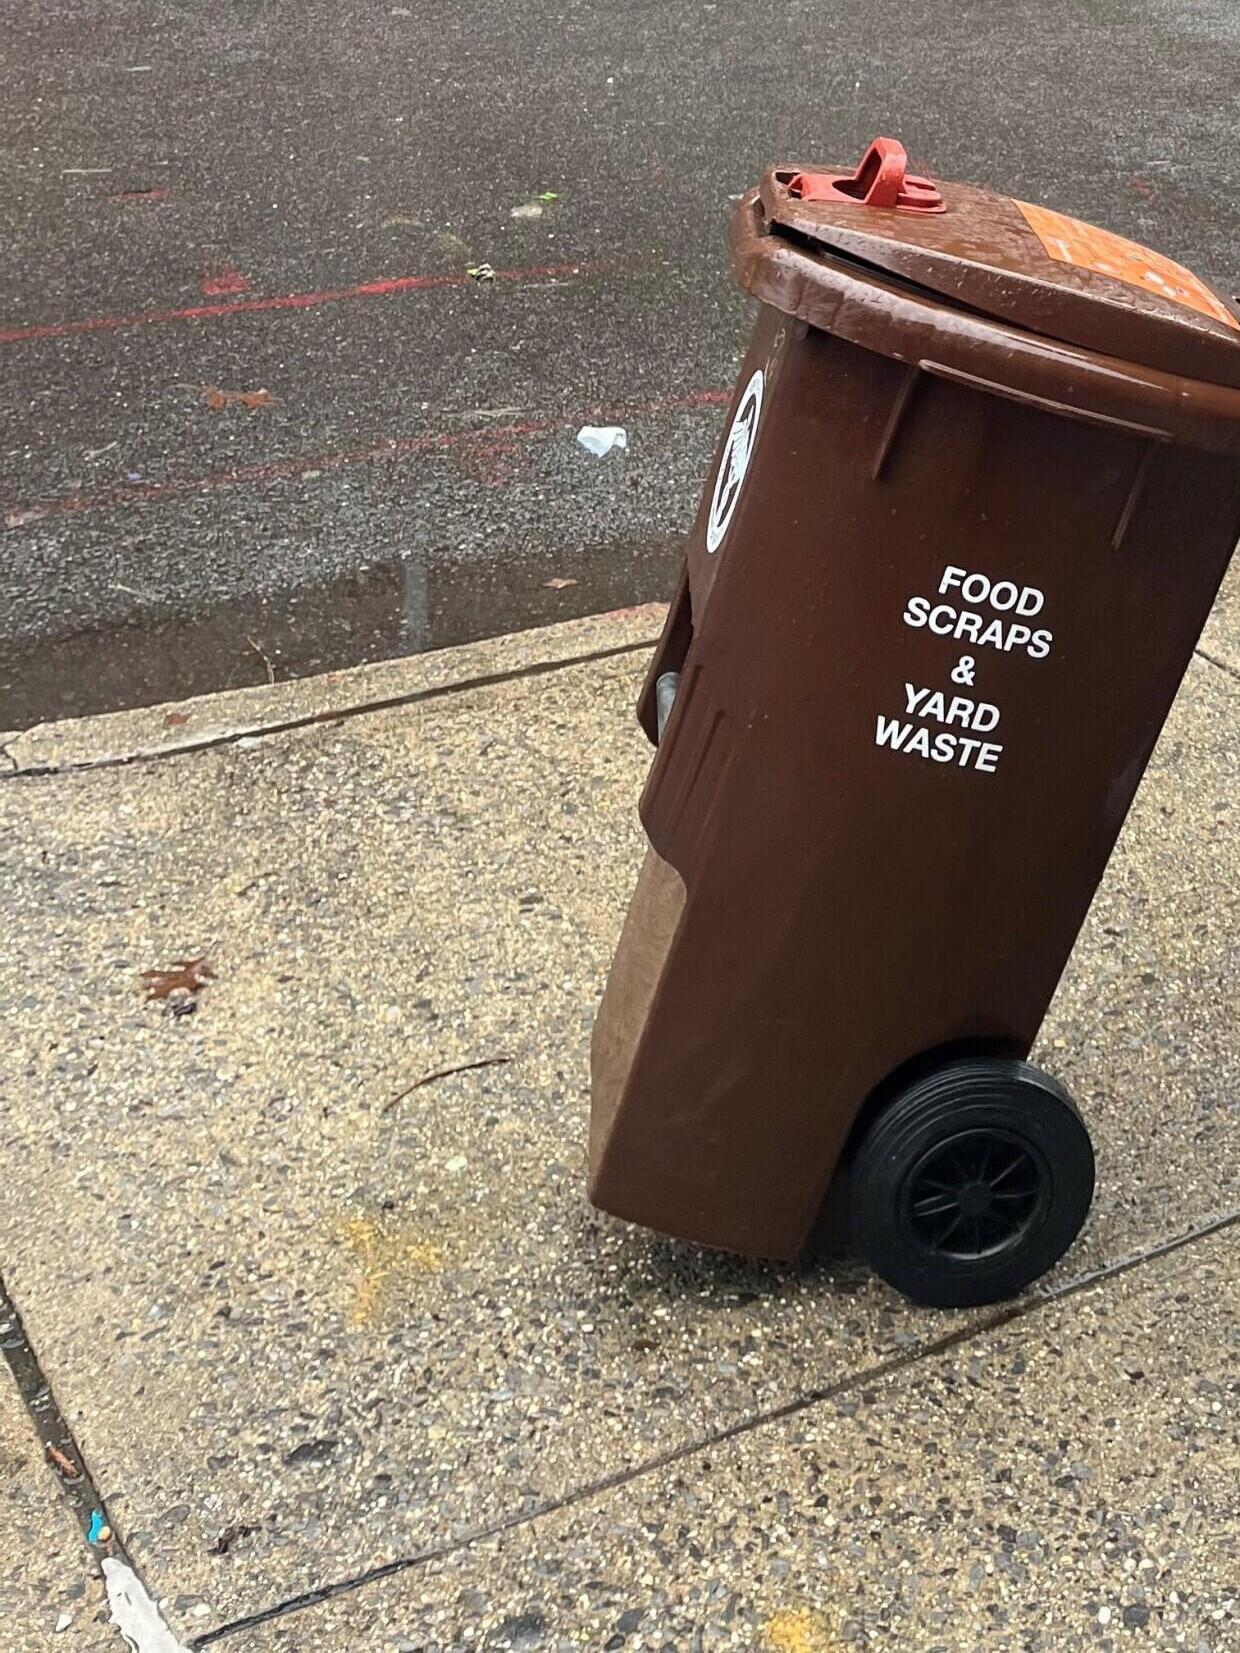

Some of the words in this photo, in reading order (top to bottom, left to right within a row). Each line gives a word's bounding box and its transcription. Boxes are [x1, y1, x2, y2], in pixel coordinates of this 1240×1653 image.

[938, 565, 1044, 617] FOOD
[903, 596, 1053, 659] SCRAPS
[951, 655, 975, 686] &
[904, 683, 1001, 732] YARD
[875, 715, 1003, 773] WASTE
